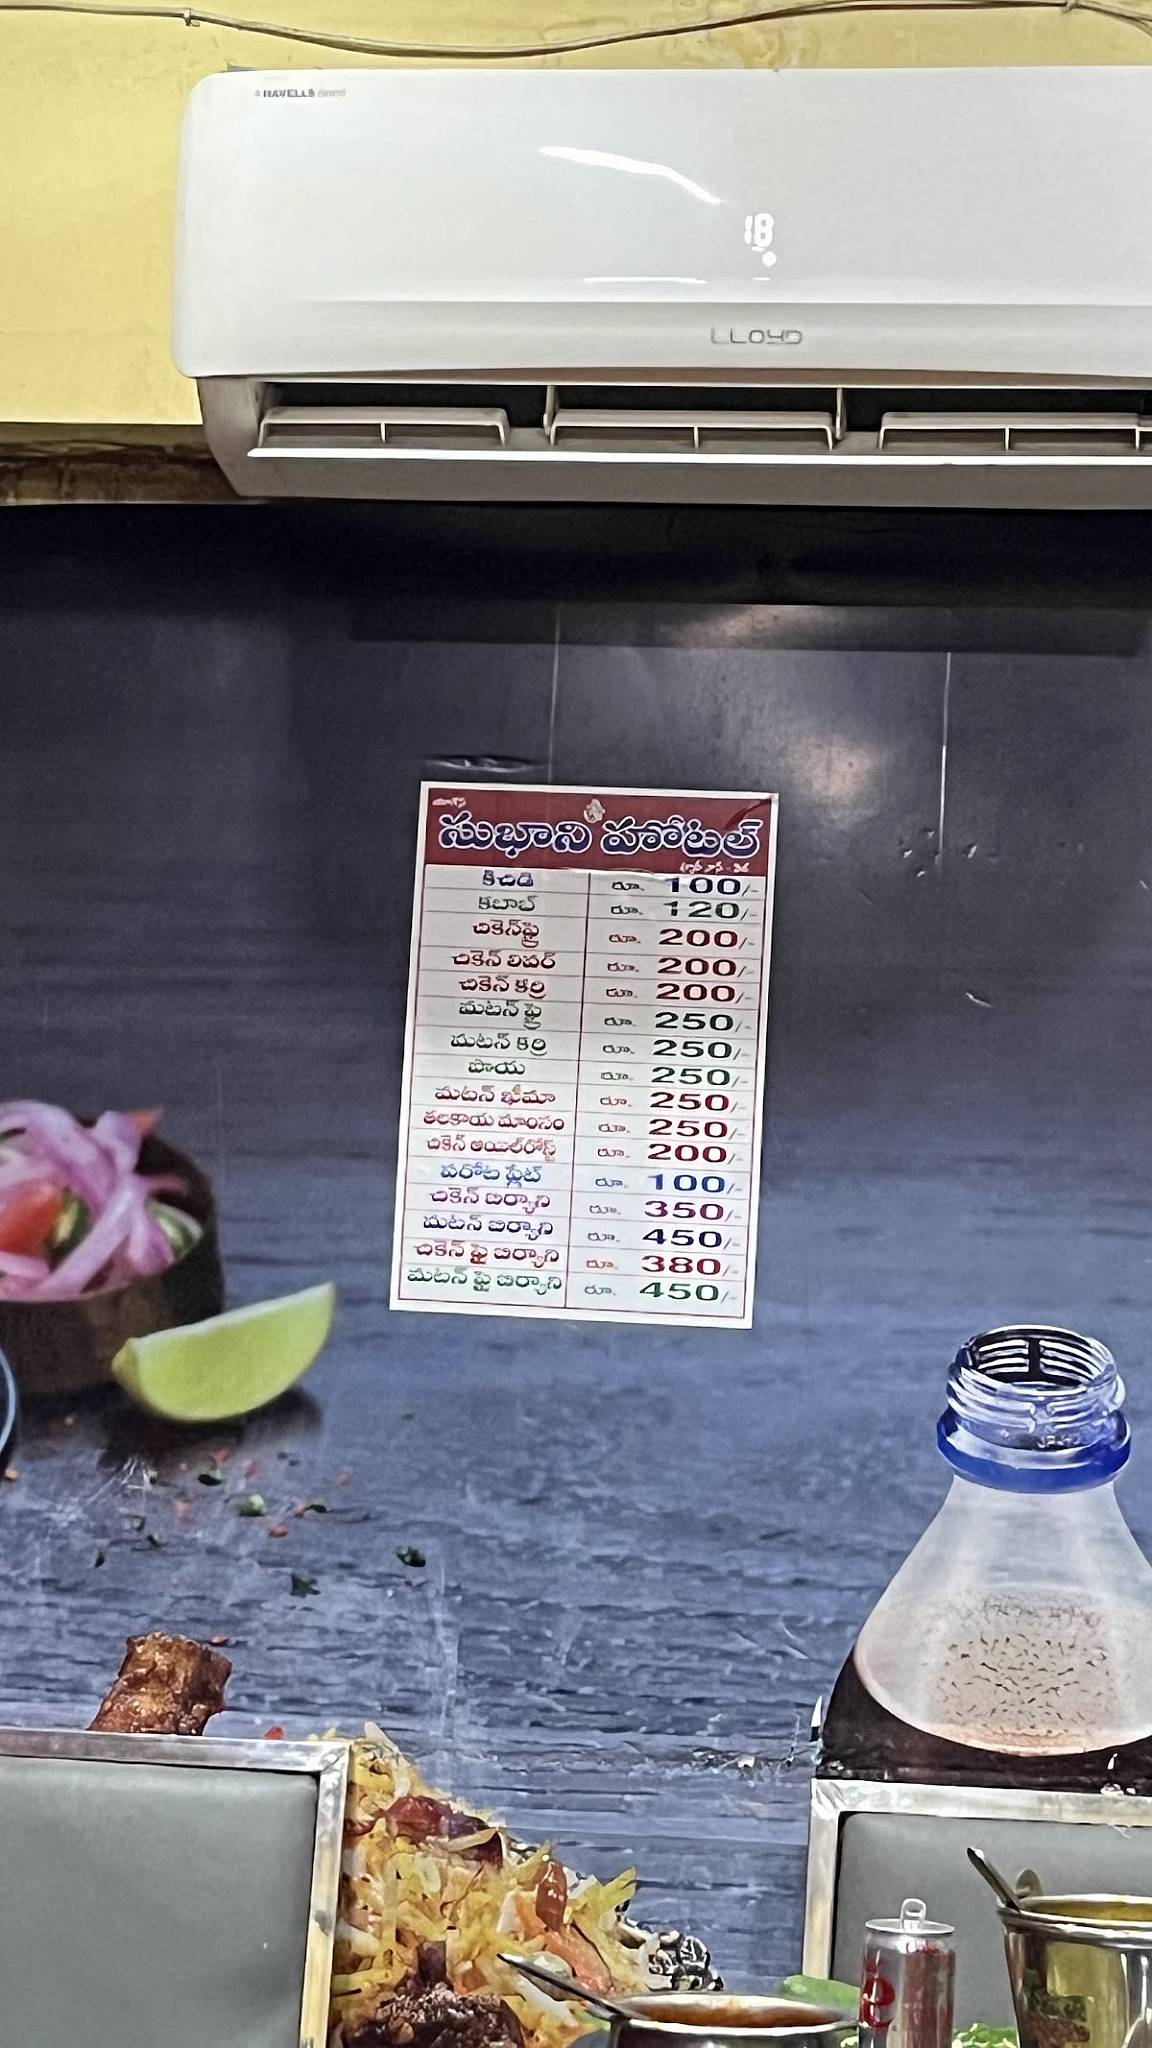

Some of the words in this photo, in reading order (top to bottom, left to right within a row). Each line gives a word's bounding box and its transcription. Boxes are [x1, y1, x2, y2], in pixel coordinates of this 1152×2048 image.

[710, 327, 803, 345] LLOYD
[438, 810, 593, 859] సుభాని
[600, 815, 764, 859] హోటల్
